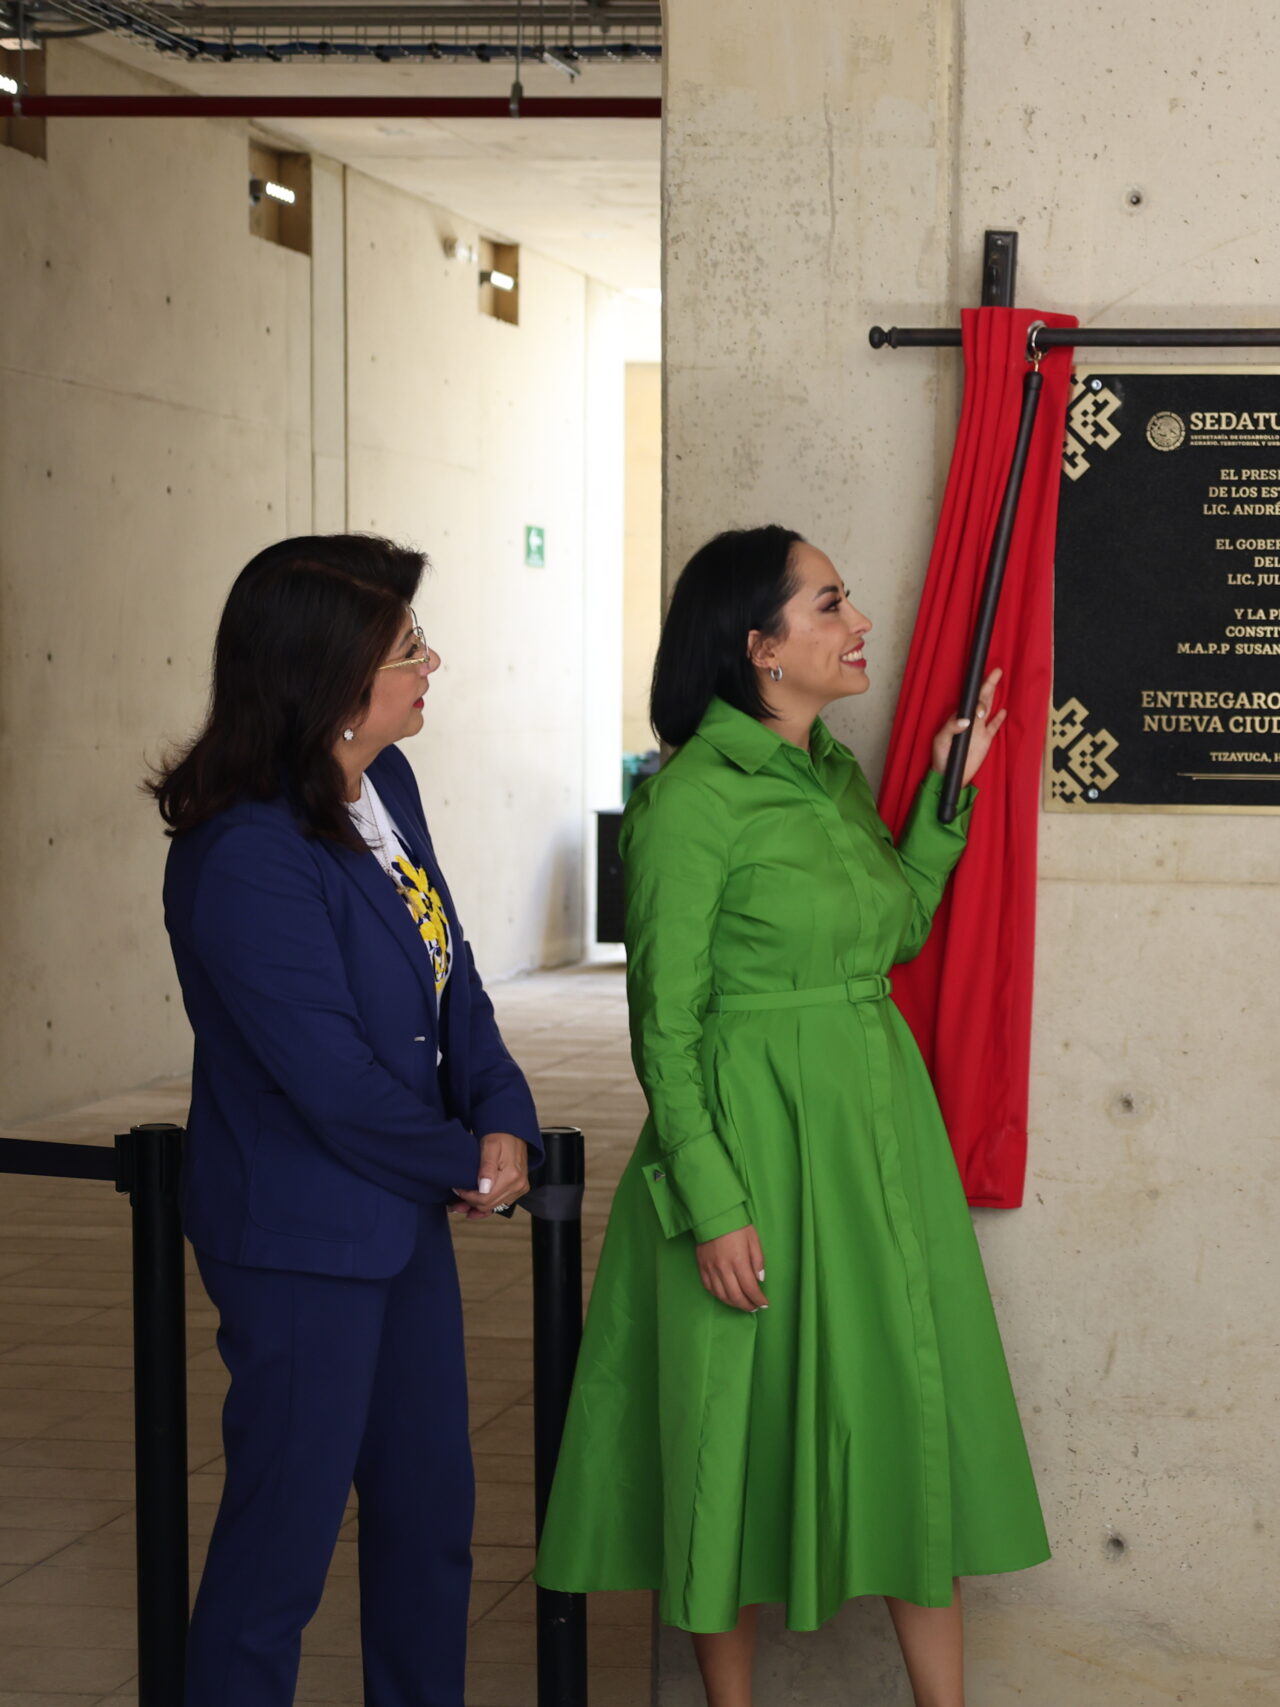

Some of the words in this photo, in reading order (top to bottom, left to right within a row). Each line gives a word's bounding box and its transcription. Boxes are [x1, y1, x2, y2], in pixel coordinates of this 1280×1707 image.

[1220, 468, 1239, 481] EL
[1208, 486, 1228, 498] DE
[1230, 486, 1258, 498] LOS
[1203, 503, 1230, 516] LIC.
[1215, 538, 1234, 550] EL
[1227, 573, 1255, 586] LIC.
[1234, 608, 1245, 620] Y
[1247, 608, 1267, 621] LA
[1177, 642, 1231, 655] M.A.P.P
[1143, 715, 1225, 733] NUEVA
[1210, 751, 1272, 764] TIZAYUCA,
